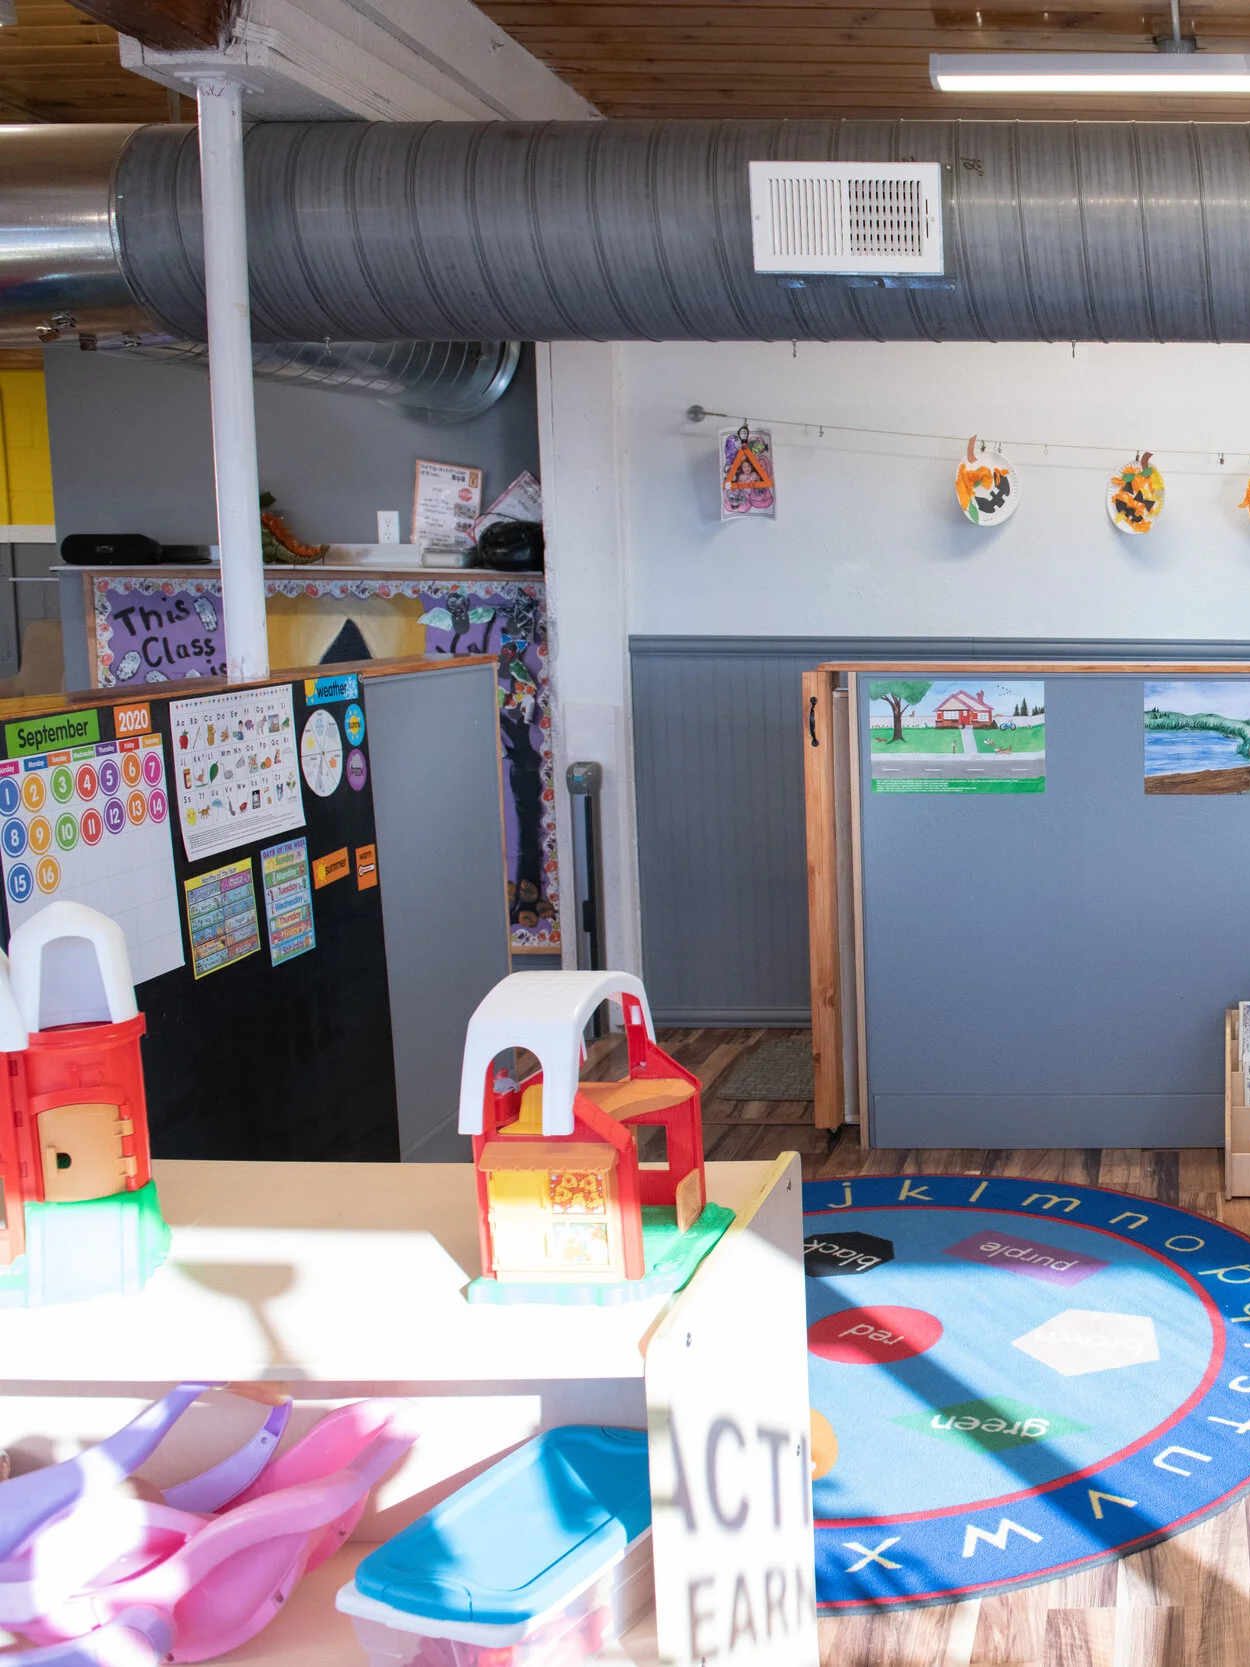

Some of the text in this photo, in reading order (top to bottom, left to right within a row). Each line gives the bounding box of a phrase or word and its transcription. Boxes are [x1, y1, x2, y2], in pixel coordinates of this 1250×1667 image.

[113, 597, 190, 636] This
[142, 637, 215, 667] Class
[317, 682, 347, 698] weather
[118, 709, 148, 732] 2020
[18, 719, 88, 750] September
[5, 761, 155, 806] 1 2 3 4 5 6 7
[10, 798, 163, 847] 8 9 10 11 12 13 14
[277, 868, 297, 881] Monday
[325, 858, 346, 875] summer
[14, 866, 55, 893] 15 16
[278, 883, 298, 895] Tuesday
[275, 896, 303, 910] Wednesday
[280, 911, 300, 924] Thursday
[827, 1182, 853, 1209] j
[899, 1179, 934, 1201] k
[969, 1180, 988, 1203] l
[1023, 1192, 1082, 1213] m
[1108, 1210, 1148, 1229] n
[803, 1239, 882, 1272] black
[979, 1238, 1080, 1273] purple
[1164, 1235, 1204, 1252] o
[843, 1322, 904, 1347] red
[931, 1415, 1051, 1440] green
[1152, 1444, 1212, 1477] u
[1088, 1488, 1138, 1520] v
[962, 1518, 1043, 1558] w
[844, 1536, 905, 1573] x
